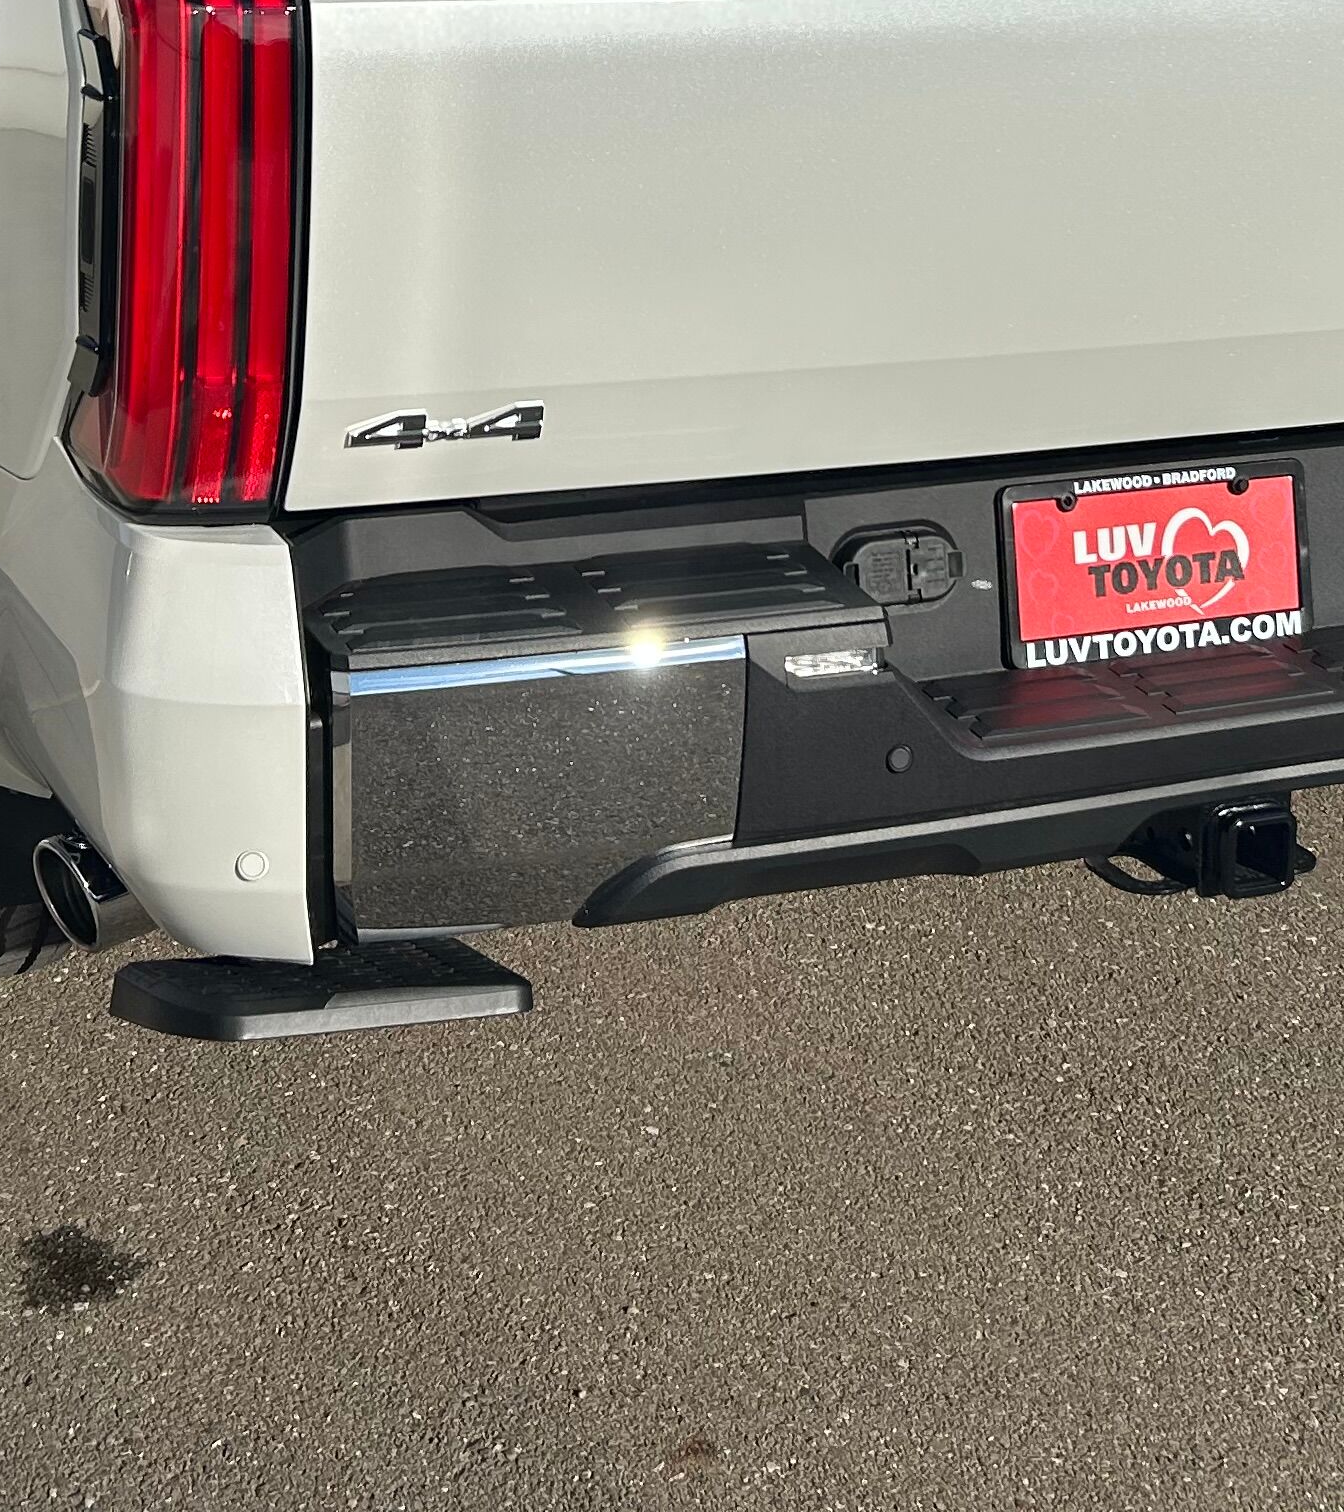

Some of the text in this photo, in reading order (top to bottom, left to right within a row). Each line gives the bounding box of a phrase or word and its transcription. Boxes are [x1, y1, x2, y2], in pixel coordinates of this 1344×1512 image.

[1073, 467, 1236, 495] LAKEWOOD BRADFORD
[1073, 522, 1156, 565] LUV
[1088, 549, 1245, 597] TOYOTA
[1126, 595, 1192, 613] LAKEWOOD
[1026, 610, 1303, 669] LUVTOYOTA.COM
